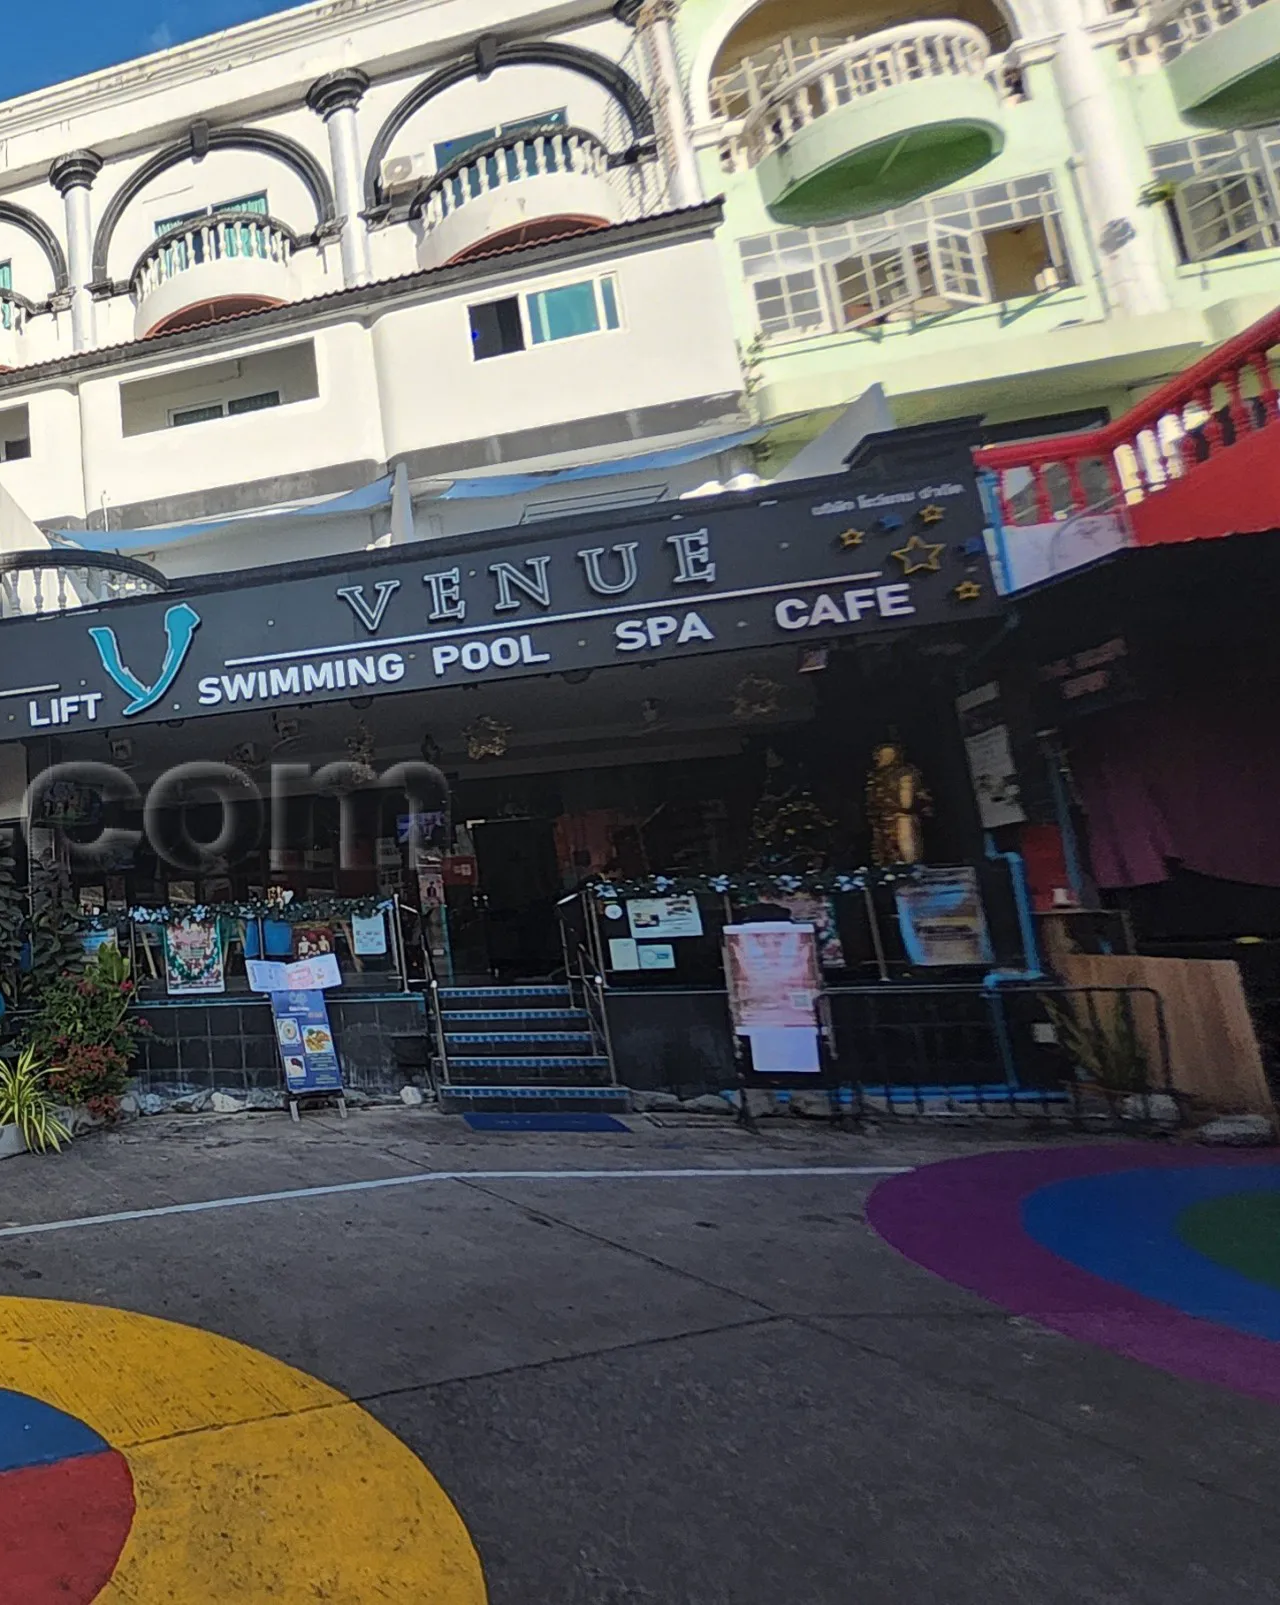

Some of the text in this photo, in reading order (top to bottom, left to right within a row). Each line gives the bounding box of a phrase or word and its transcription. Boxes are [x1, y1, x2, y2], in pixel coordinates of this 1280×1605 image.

[337, 527, 717, 632] VENUE
[197, 582, 917, 705] SWIMMING POOL SPA CAFE
[29, 692, 103, 727] LIFT
